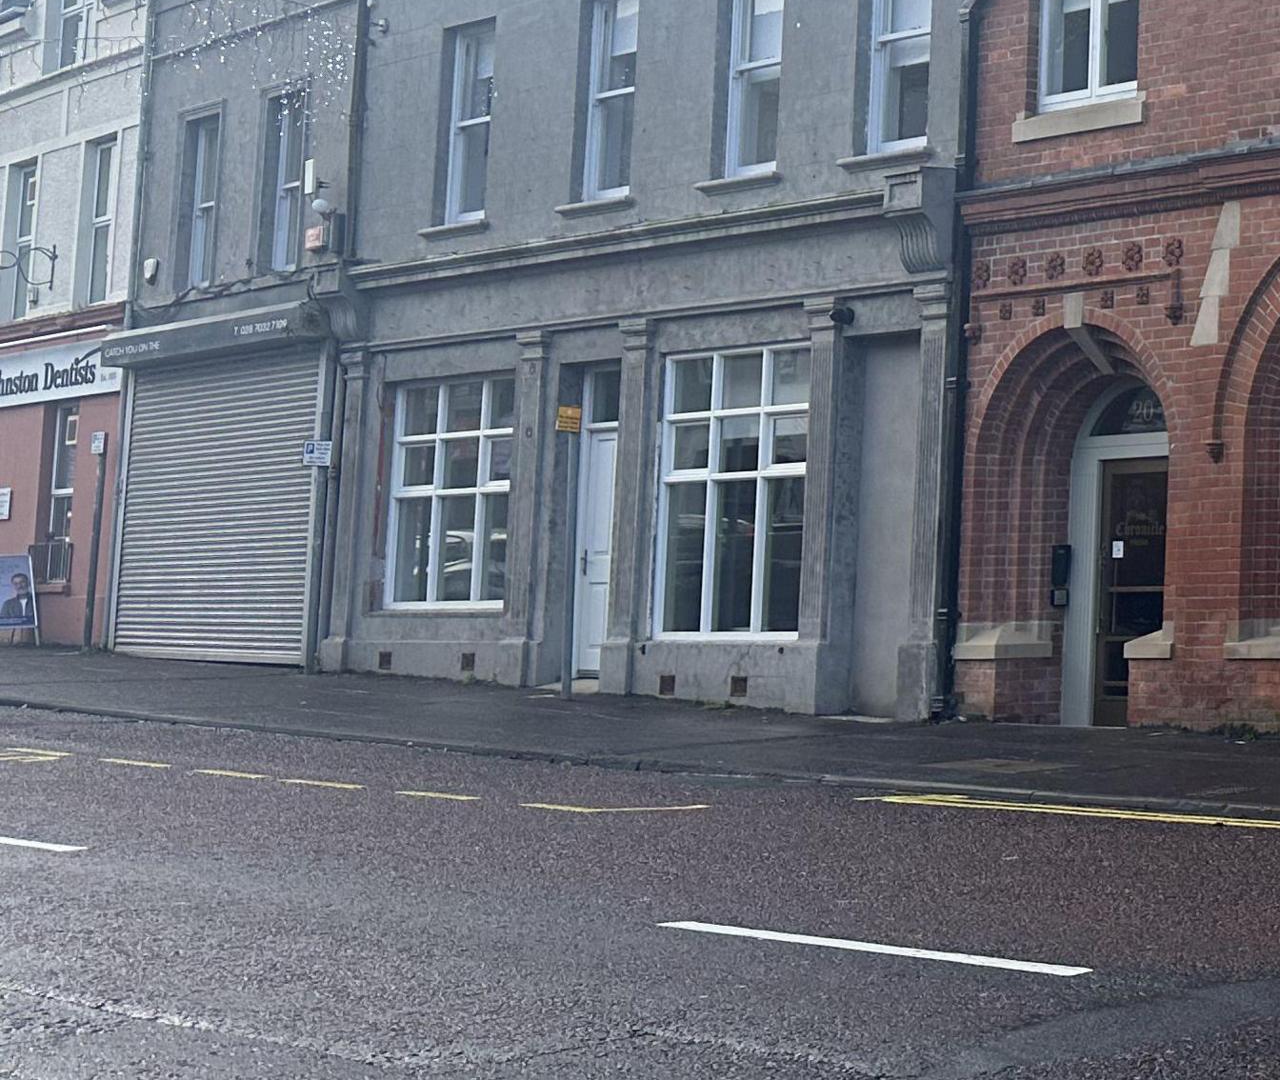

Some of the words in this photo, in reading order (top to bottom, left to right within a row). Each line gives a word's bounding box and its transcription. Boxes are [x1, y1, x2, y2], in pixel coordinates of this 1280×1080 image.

[150, 341, 160, 350] THE
[43, 357, 96, 390] Dentists
[1133, 400, 1153, 422] 20
